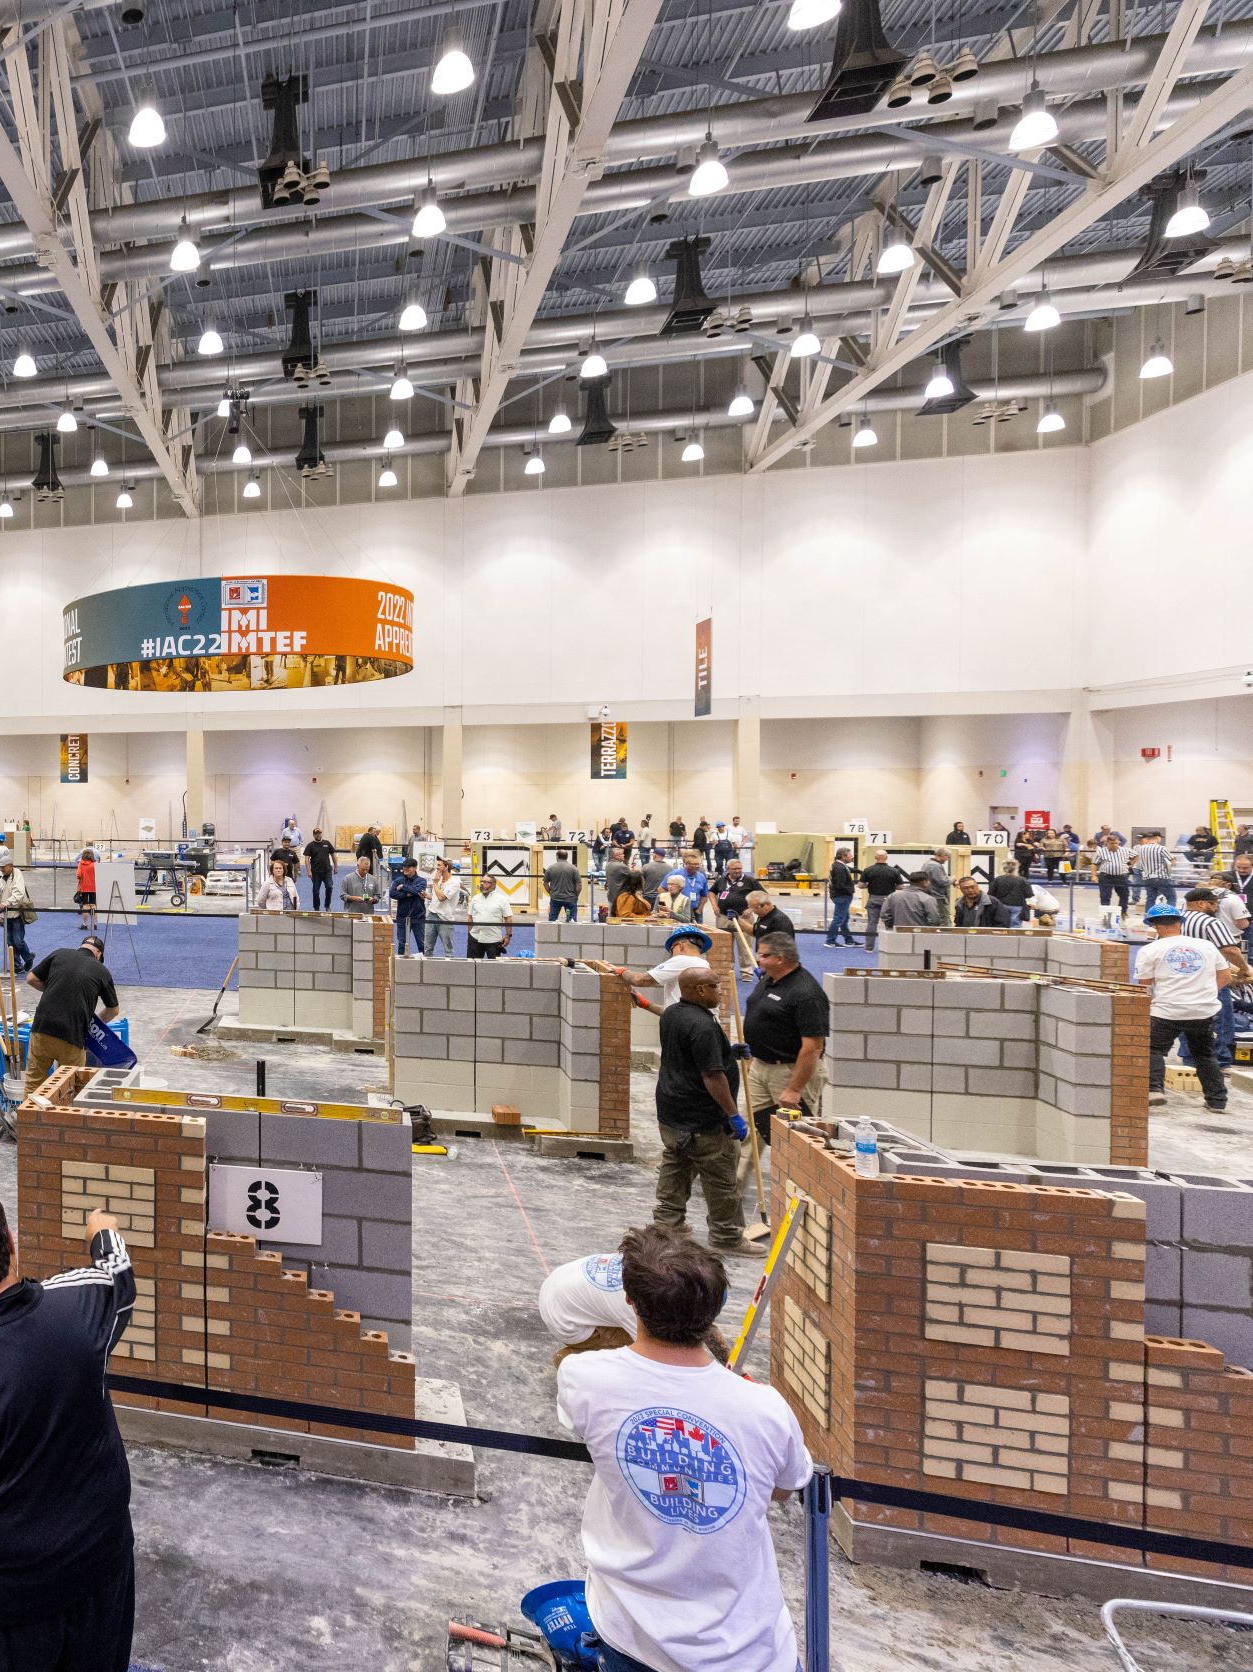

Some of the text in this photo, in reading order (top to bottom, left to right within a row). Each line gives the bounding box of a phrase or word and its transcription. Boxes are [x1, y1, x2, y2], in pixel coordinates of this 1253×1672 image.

[377, 591, 405, 624] 2022
[64, 608, 81, 640] NAL
[221, 609, 267, 631] IMI
[141, 633, 221, 657] #IAC22
[221, 631, 307, 653] IMTEF
[698, 645, 707, 691] TILE
[68, 735, 80, 780] CONCRET
[474, 831, 491, 841] 73
[568, 831, 586, 842] 72
[849, 824, 865, 833] 78
[870, 833, 888, 844] 71
[983, 833, 1004, 844] 70
[246, 1180, 281, 1229] 8
[629, 1409, 726, 1444] 2022 SPECIAL CONVENTION
[627, 1444, 732, 1475] BUILDING
[627, 1455, 735, 1484] COMMUNITIES
[650, 1493, 718, 1518] BUILDING
[671, 1506, 699, 1523] LIVES
[547, 1614, 574, 1633] IMTEF
